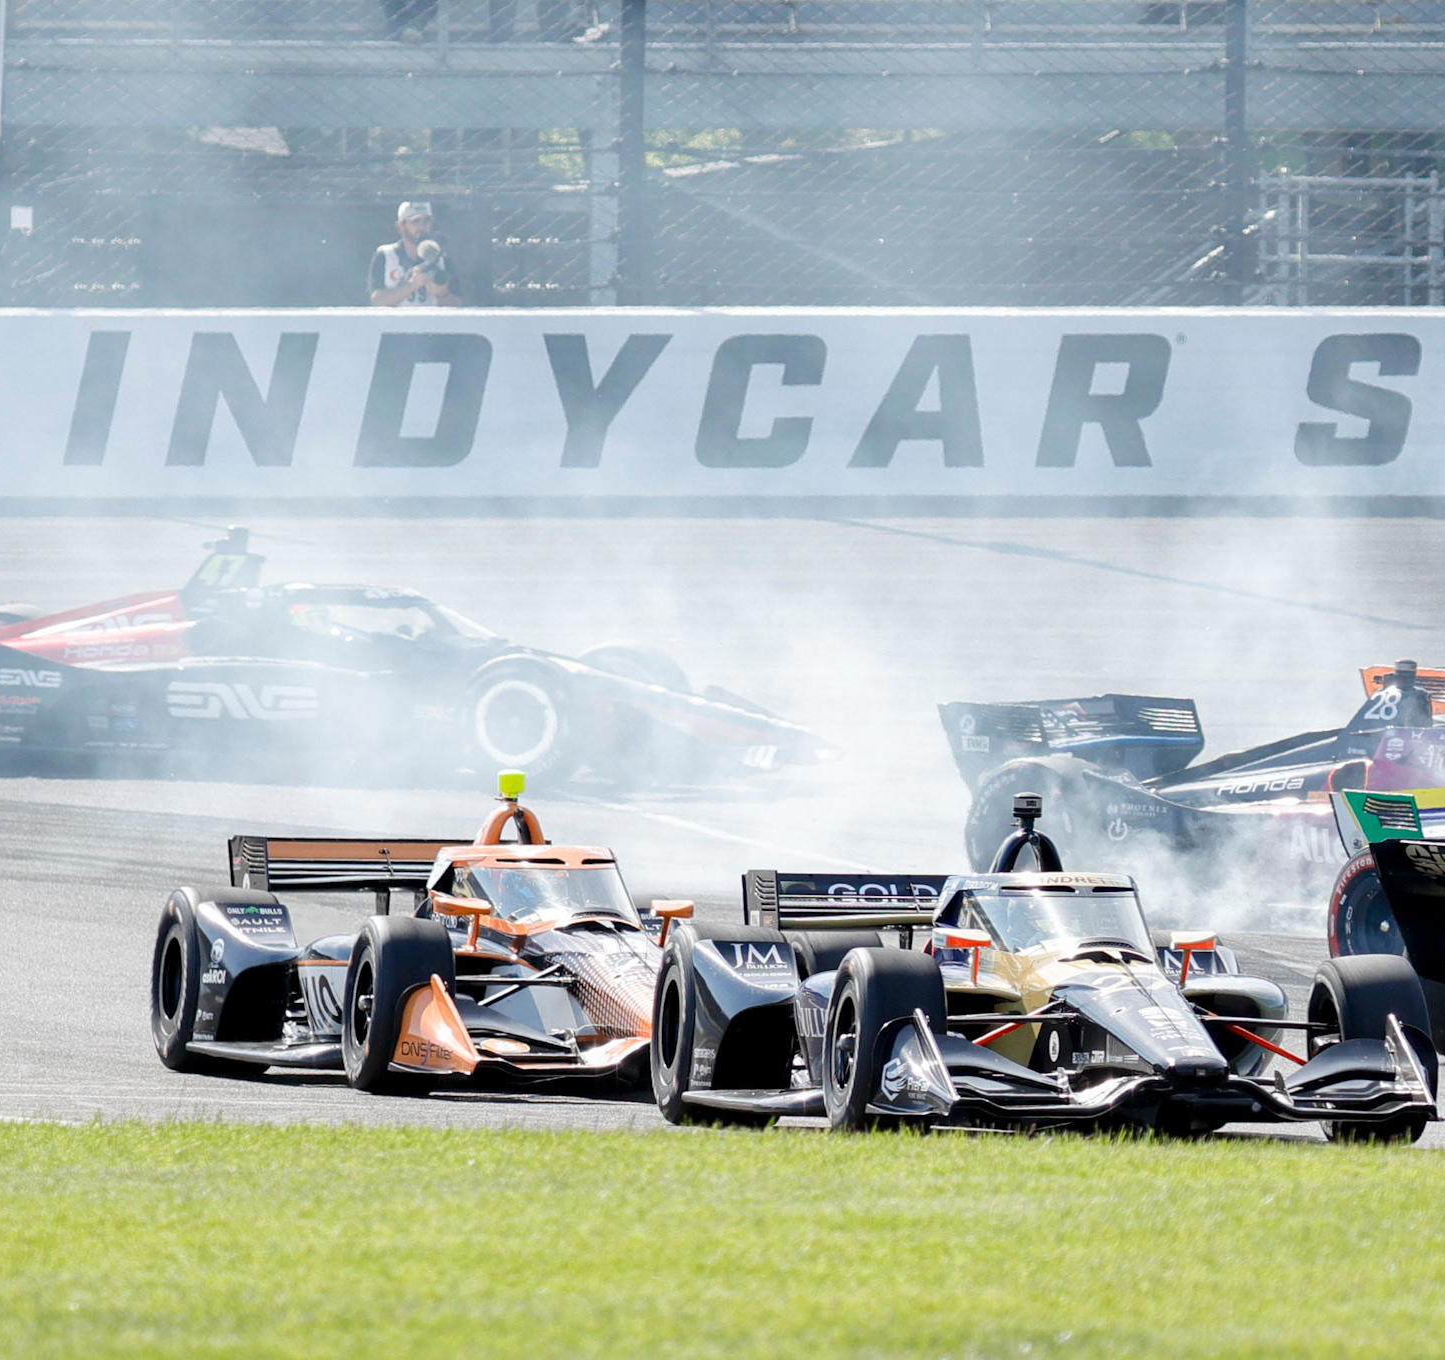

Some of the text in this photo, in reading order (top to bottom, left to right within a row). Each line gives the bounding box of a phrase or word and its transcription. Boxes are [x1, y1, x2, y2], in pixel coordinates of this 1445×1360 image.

[62, 330, 1176, 470] INDYCAR
[198, 554, 246, 587] 47
[63, 642, 150, 660] Honda
[1364, 686, 1402, 721] 28
[1217, 776, 1306, 796] Honda
[827, 882, 939, 904] GOLD
[259, 906, 283, 915] BULLS
[729, 943, 787, 969] JM
